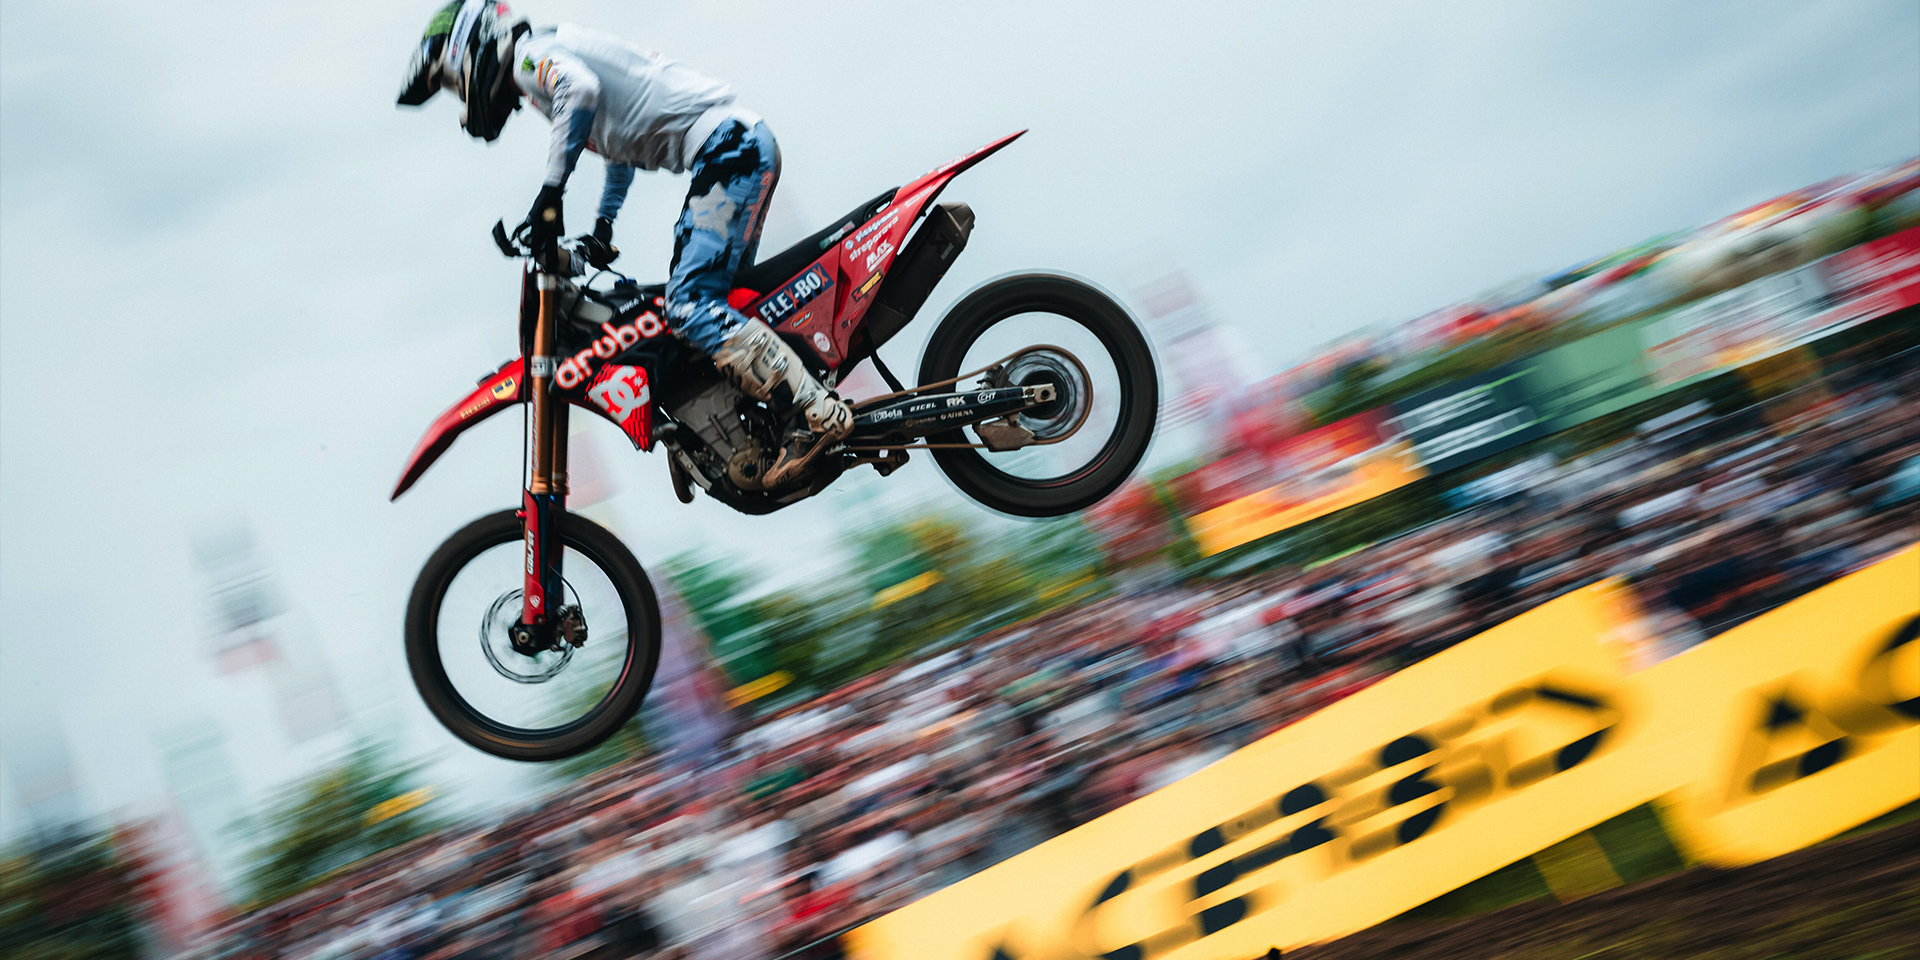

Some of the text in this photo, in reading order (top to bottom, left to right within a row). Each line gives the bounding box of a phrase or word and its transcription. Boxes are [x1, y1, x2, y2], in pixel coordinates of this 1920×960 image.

[759, 264, 829, 324] FLEX-BOX
[619, 293, 645, 315] DUCAI
[909, 402, 937, 412] EXCEL
[946, 396, 966, 408] RK
[947, 409, 973, 419] ATHENA
